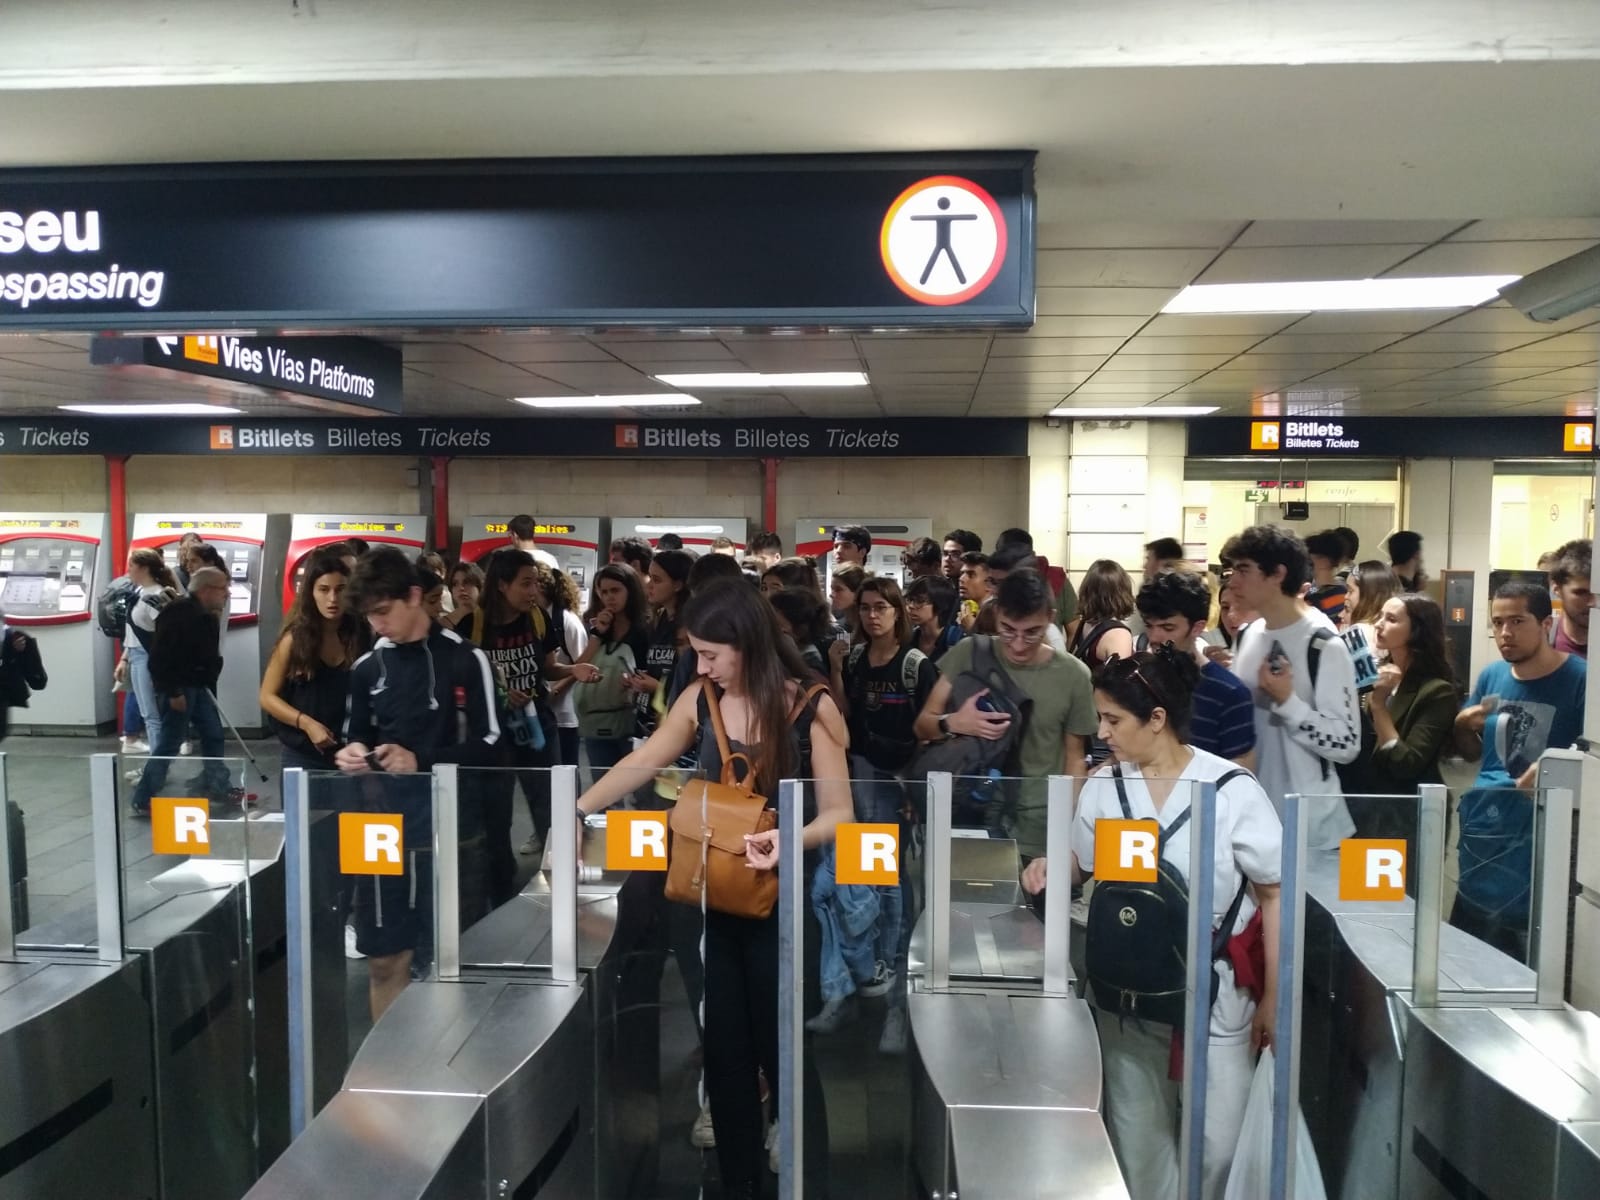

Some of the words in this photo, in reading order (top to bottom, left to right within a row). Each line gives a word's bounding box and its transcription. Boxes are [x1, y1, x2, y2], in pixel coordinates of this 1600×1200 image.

[0, 263, 164, 308] spassing
[221, 336, 263, 373] Vies
[267, 346, 304, 383] Vías
[309, 358, 375, 398] Platforms
[19, 428, 90, 446] Tickets
[238, 428, 315, 447] Bitllets
[327, 428, 402, 447] Billetes
[417, 428, 491, 447] Tickets
[644, 428, 721, 447] Bitllets
[735, 428, 810, 448] Billetes
[825, 428, 900, 448] Tickets
[1285, 438, 1323, 448] Billetes
[1325, 438, 1360, 448] Tickets
[1286, 422, 1344, 437] Bitllets
[174, 806, 209, 844] R
[364, 823, 401, 863] R
[630, 819, 666, 858] R
[860, 832, 897, 873] R
[1119, 830, 1156, 869] R
[1365, 848, 1404, 888] R
